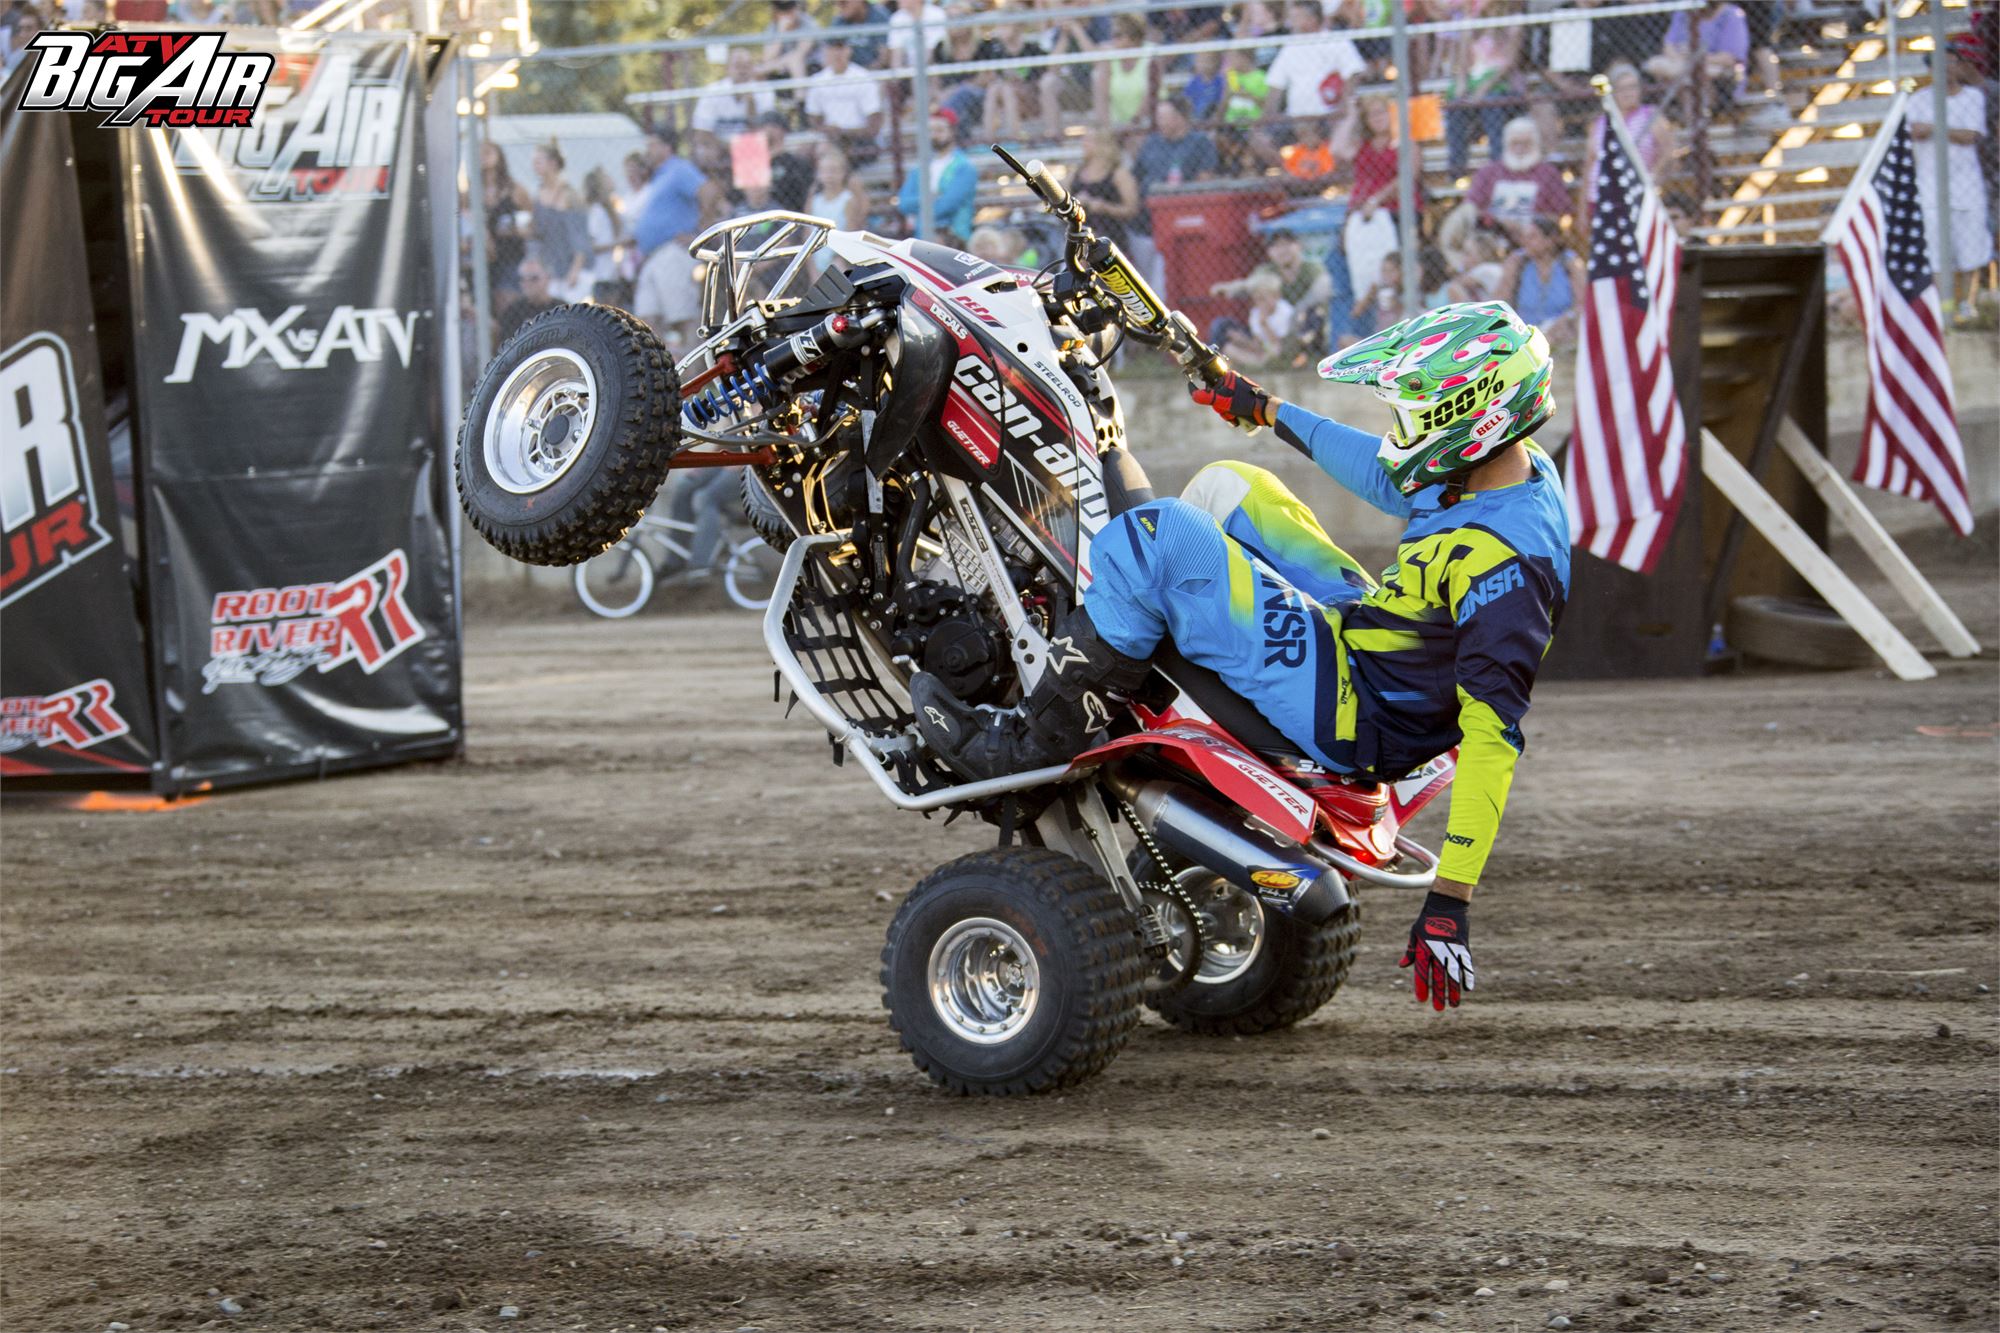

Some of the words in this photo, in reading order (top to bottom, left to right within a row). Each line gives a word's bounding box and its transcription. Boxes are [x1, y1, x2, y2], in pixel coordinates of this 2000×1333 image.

[929, 302, 969, 340] DECALS
[1033, 360, 1082, 409] STEELROD
[1418, 368, 1505, 431] 100%
[946, 419, 991, 466] GUETTER
[1475, 413, 1505, 437] BELL
[212, 583, 337, 623] ROOT
[211, 617, 342, 657] RIVER
[1237, 762, 1310, 816] GUETTER
